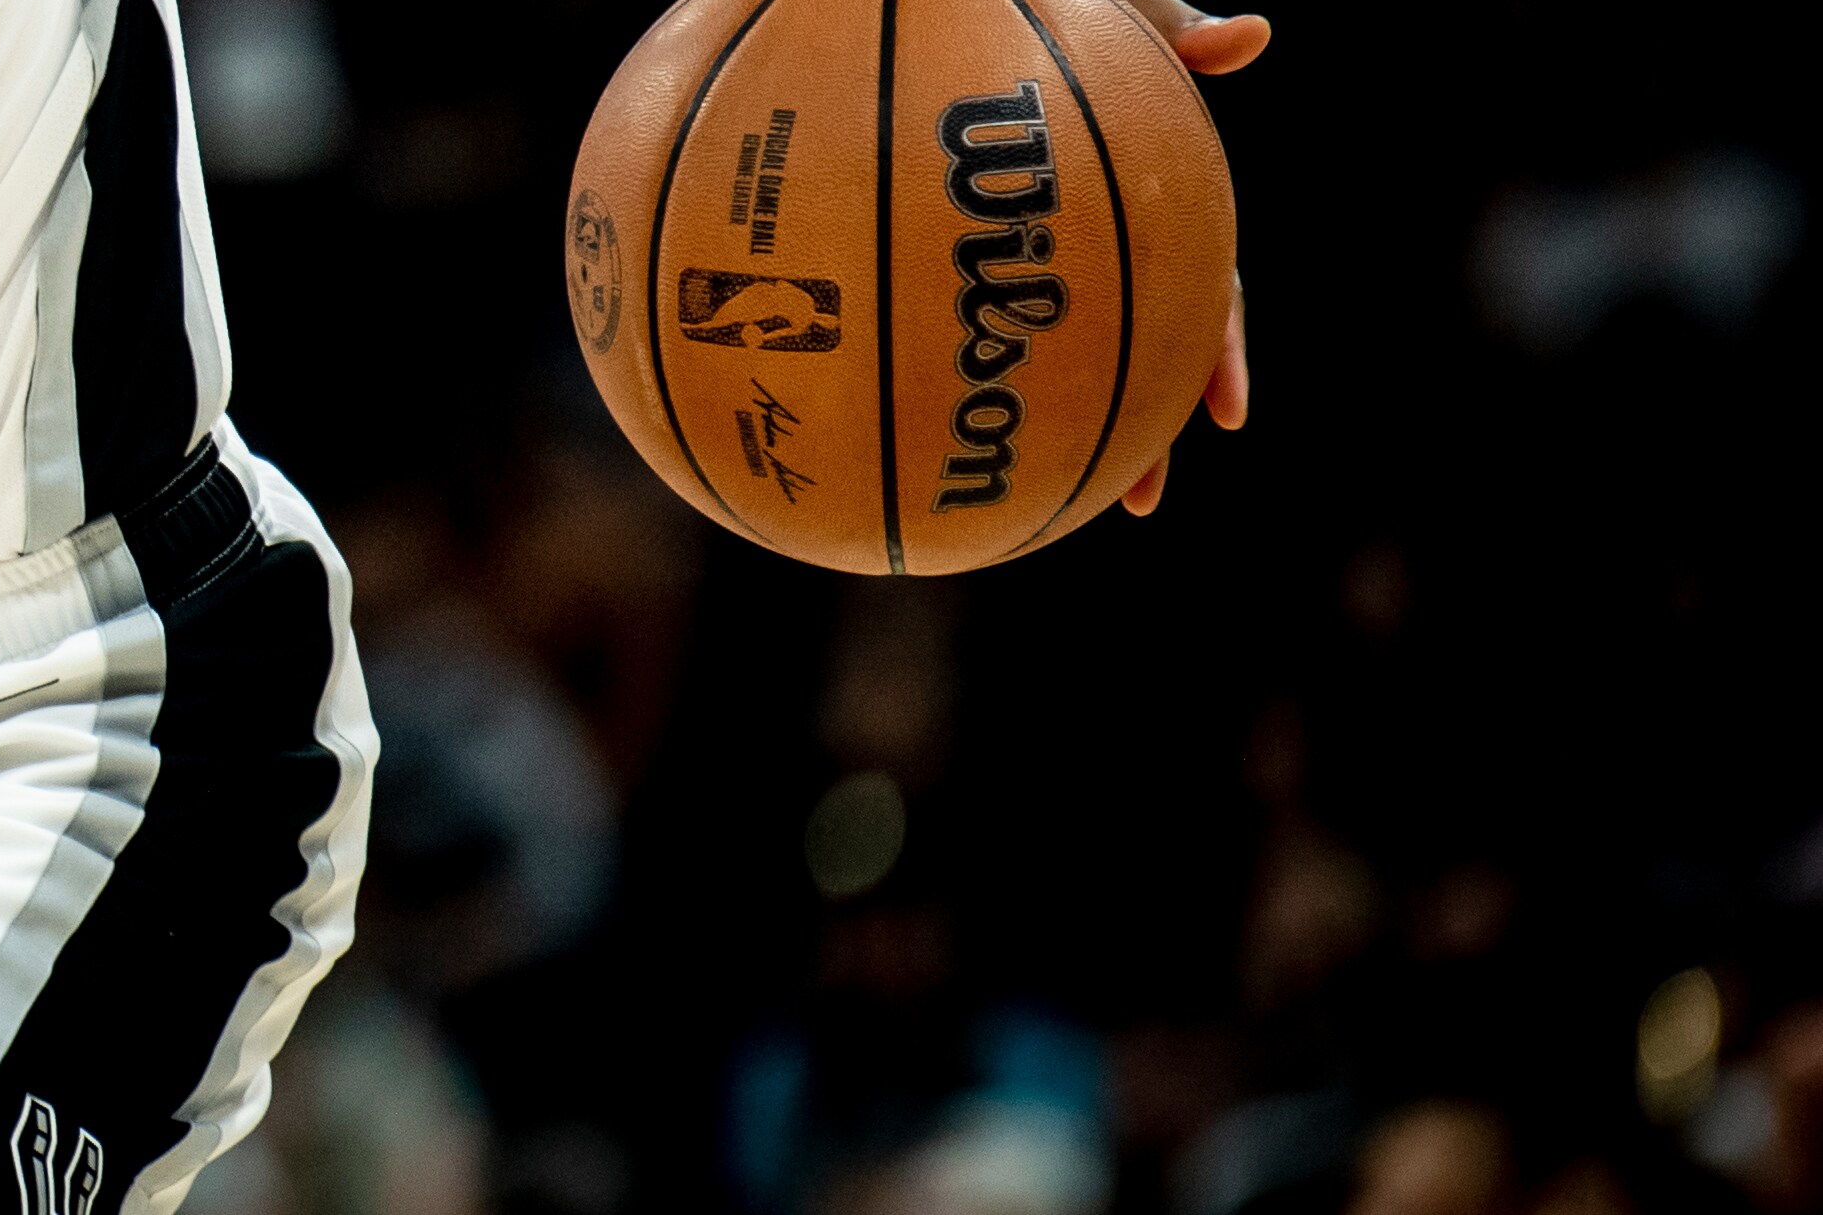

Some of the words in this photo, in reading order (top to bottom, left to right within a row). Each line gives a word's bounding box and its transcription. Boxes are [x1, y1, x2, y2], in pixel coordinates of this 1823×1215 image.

[760, 108, 797, 170] OFFICIAL
[729, 179, 752, 225] LEATHER
[753, 174, 784, 217] GAME
[750, 220, 776, 255] BALL
[931, 79, 1070, 514] Wilson
